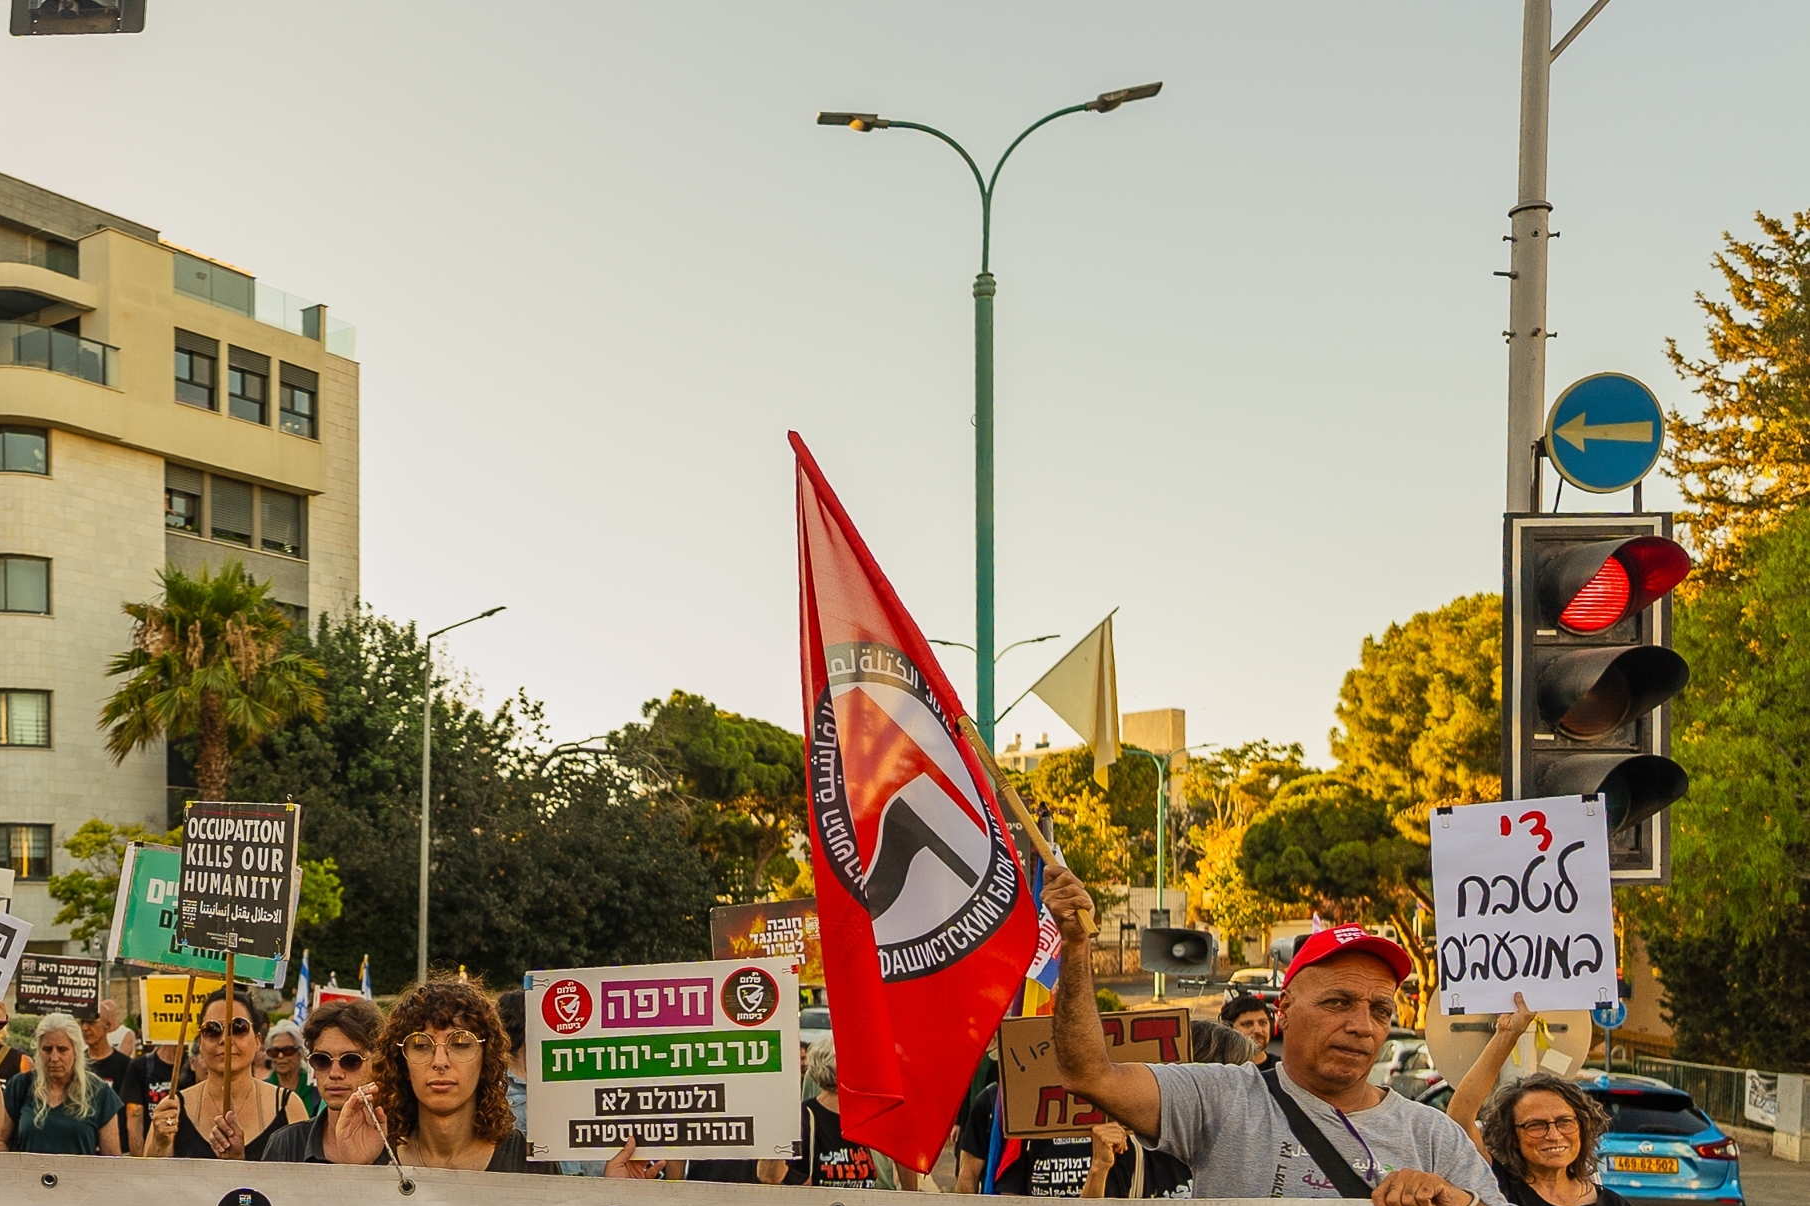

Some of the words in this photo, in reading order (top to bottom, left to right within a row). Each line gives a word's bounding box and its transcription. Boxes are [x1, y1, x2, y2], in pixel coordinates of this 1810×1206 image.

[187, 817, 286, 844] OCCUPATION
[821, 808, 857, 863] הגוש
[1500, 810, 1553, 852] די
[185, 842, 233, 869] KILLS
[241, 846, 284, 873] OUR
[183, 870, 283, 901] HUMANITY
[990, 851, 1017, 905] БЛОК
[1457, 840, 1585, 918] לטבח
[231, 904, 250, 923] يقتل
[251, 906, 282, 924] الاحتلال
[767, 917, 803, 931] חובה
[749, 927, 804, 945] להתנגד
[761, 940, 805, 956] לטרור
[38, 962, 58, 973] היא
[59, 964, 97, 976] שתיקה
[1440, 931, 1604, 991] במורעבים
[57, 975, 96, 987] הסכמה
[740, 975, 762, 983] שלום
[20, 983, 58, 996] מלחמה
[60, 987, 96, 999] לפשעי
[164, 993, 183, 1004] הם
[556, 986, 577, 994] שלום
[607, 985, 708, 1021] חיפה
[736, 1013, 763, 1021] ביטחון
[556, 1022, 581, 1032] ביטחון
[552, 1040, 770, 1072] ערבית-יהודית
[601, 1088, 631, 1111] לא
[637, 1087, 717, 1110] ולעולם
[575, 1122, 679, 1143] פשיסטית
[687, 1121, 747, 1142] תהיה
[821, 1163, 877, 1179] עצור
